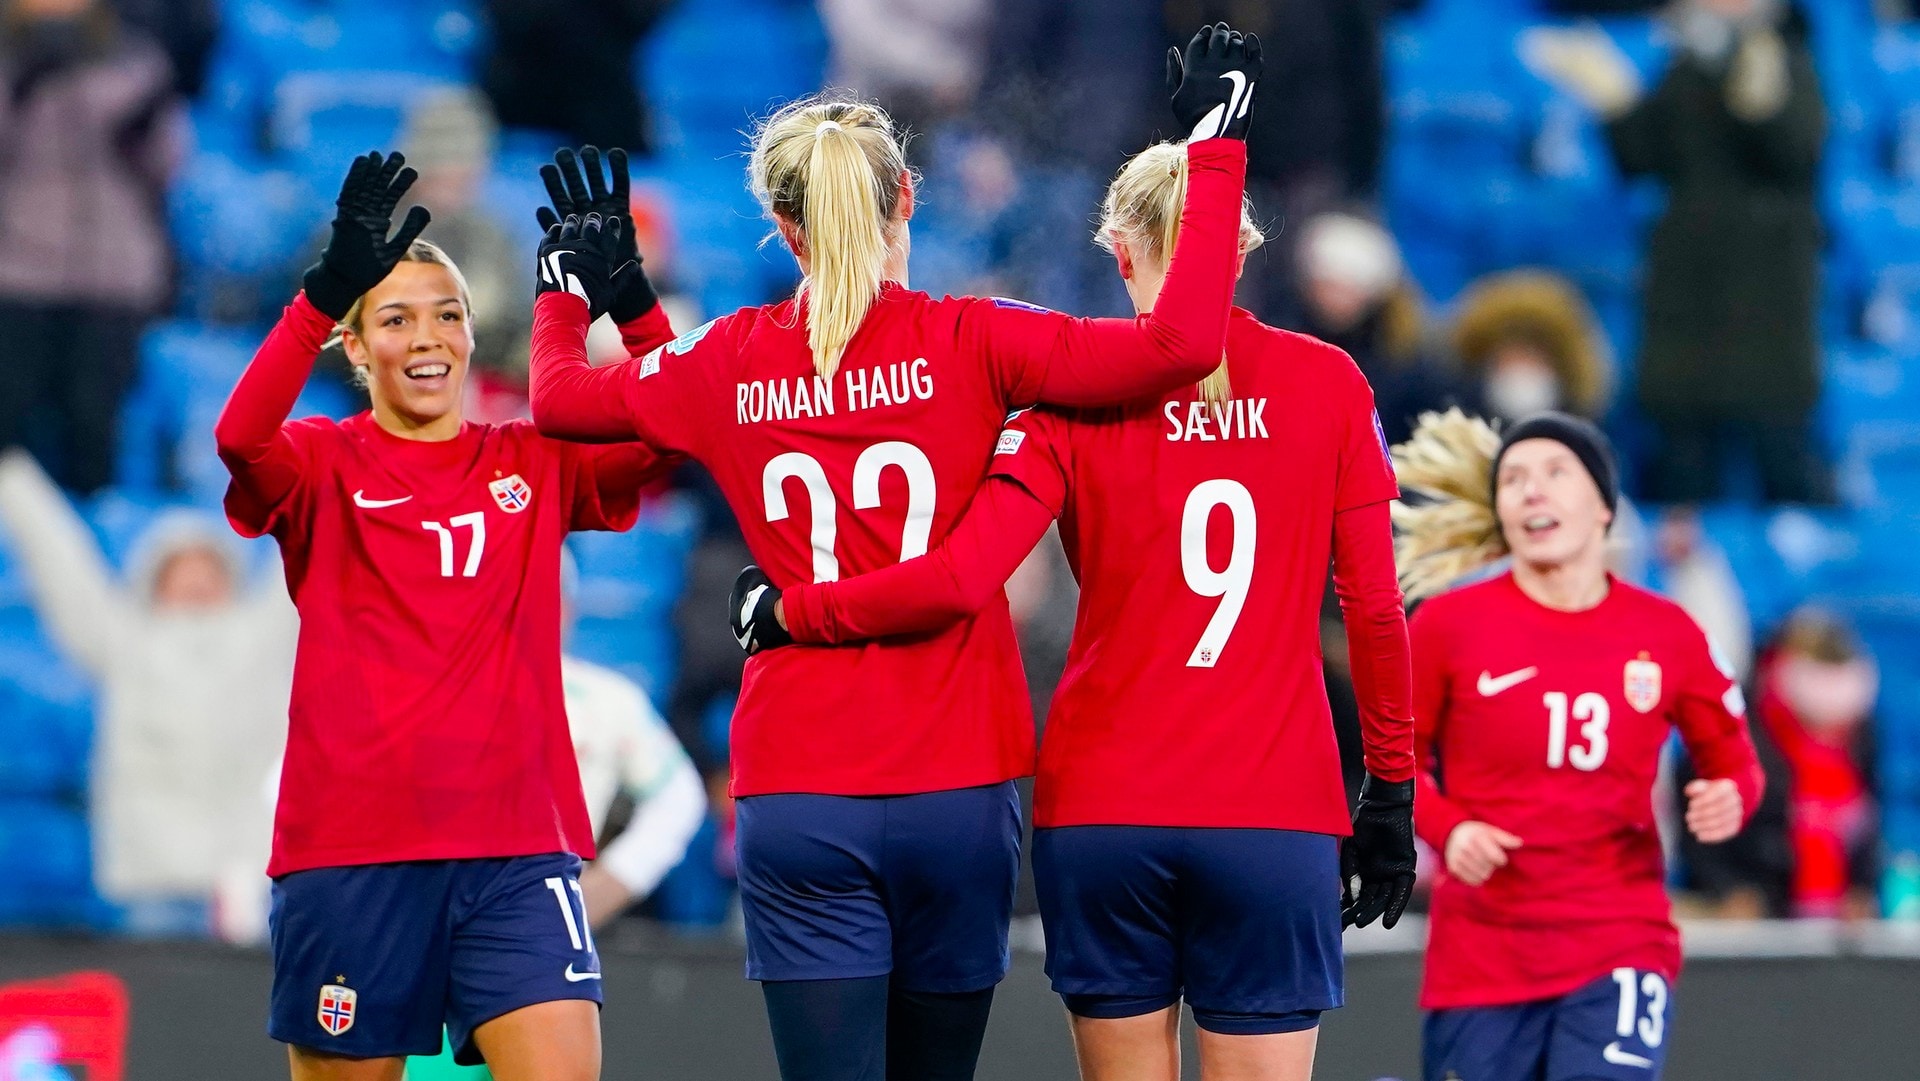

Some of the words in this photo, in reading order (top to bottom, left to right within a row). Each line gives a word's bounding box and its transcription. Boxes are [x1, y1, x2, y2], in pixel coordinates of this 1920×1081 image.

[736, 375, 835, 424] ROMAN
[845, 357, 934, 412] HAUG
[1164, 398, 1269, 442] SÆVIK
[421, 511, 486, 577] 17
[763, 441, 936, 584] 22
[1180, 478, 1257, 668] 9
[1542, 691, 1610, 771] 13
[1612, 967, 1667, 1048] 13
